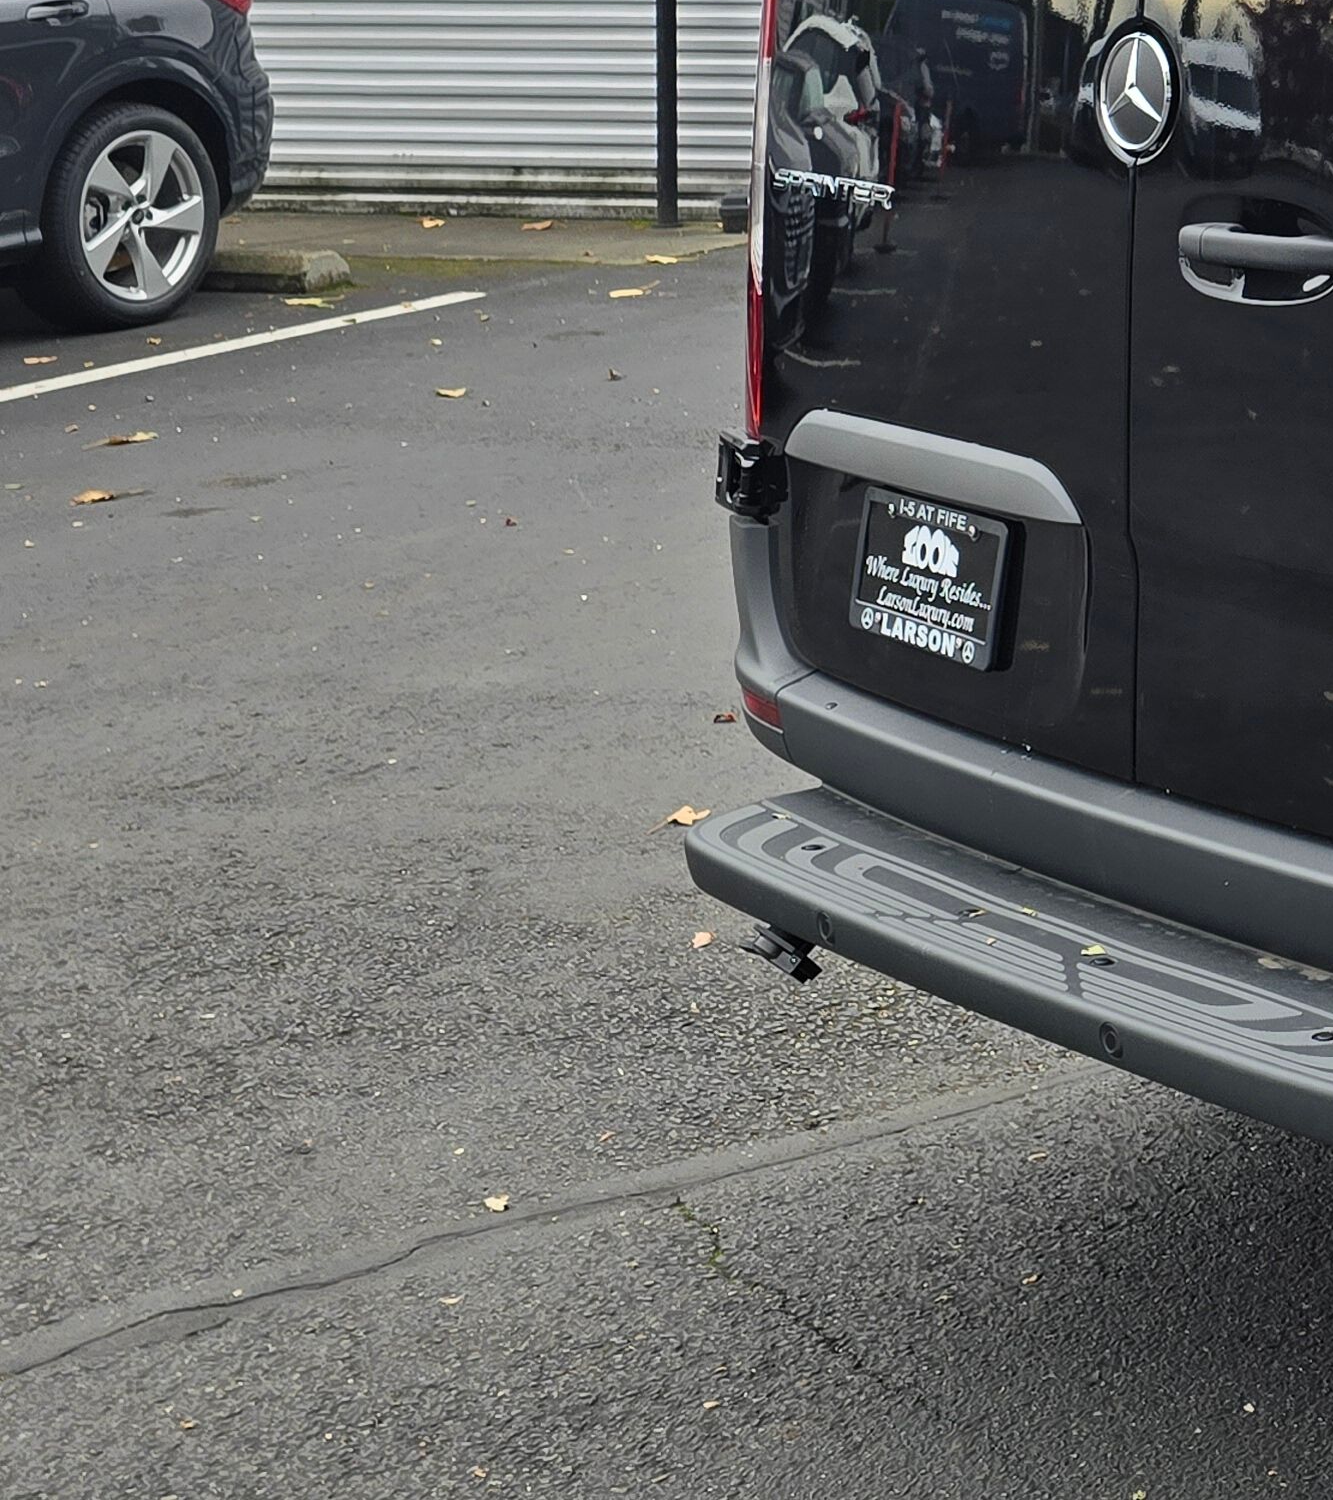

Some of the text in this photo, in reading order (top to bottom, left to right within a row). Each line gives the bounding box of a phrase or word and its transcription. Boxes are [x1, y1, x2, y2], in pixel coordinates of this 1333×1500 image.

[773, 168, 895, 210] SPRINTER
[900, 499, 967, 531] I-5 AT FIFE
[866, 555, 900, 583] Where
[900, 566, 940, 602] Luxury
[877, 586, 975, 632] LarsonLuxury.com
[880, 613, 956, 657] LARSON
